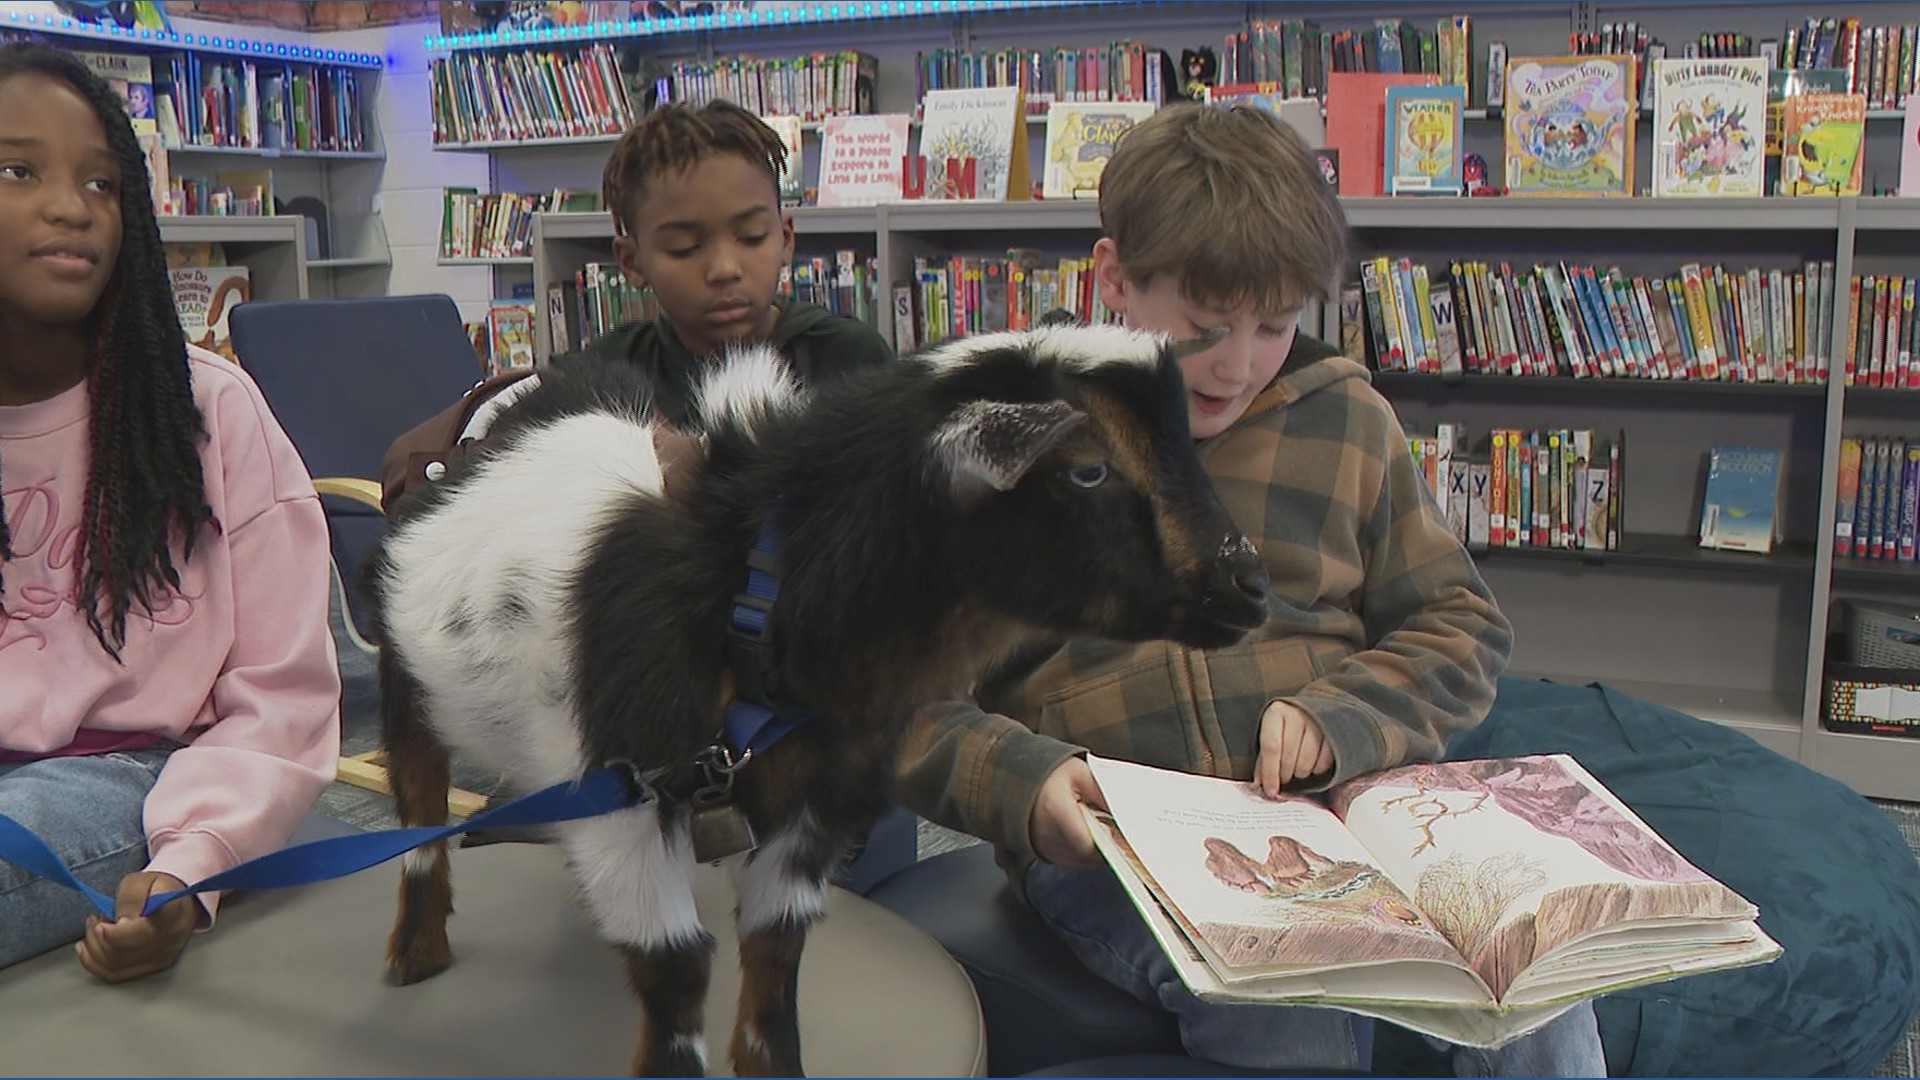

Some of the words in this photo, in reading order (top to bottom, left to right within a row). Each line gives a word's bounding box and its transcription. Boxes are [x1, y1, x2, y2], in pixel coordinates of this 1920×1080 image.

[96, 55, 128, 71] CLARK
[1545, 73, 1575, 93] PARTY
[1665, 66, 1690, 86] Dirty
[1694, 63, 1739, 80] Laundry
[1741, 66, 1762, 86] Pile
[1403, 104, 1451, 115] WEATHER
[835, 133, 853, 144] The
[858, 132, 891, 144] World
[831, 160, 874, 171] Explore
[828, 174, 850, 184] Line
[173, 271, 192, 282] How
[195, 270, 208, 282] Do
[551, 297, 562, 315] N
[898, 297, 908, 316] S
[1347, 301, 1359, 321] V
[1432, 302, 1452, 325] W
[1452, 472, 1464, 494] X
[1474, 474, 1487, 496] Y
[1592, 480, 1604, 503] Z
